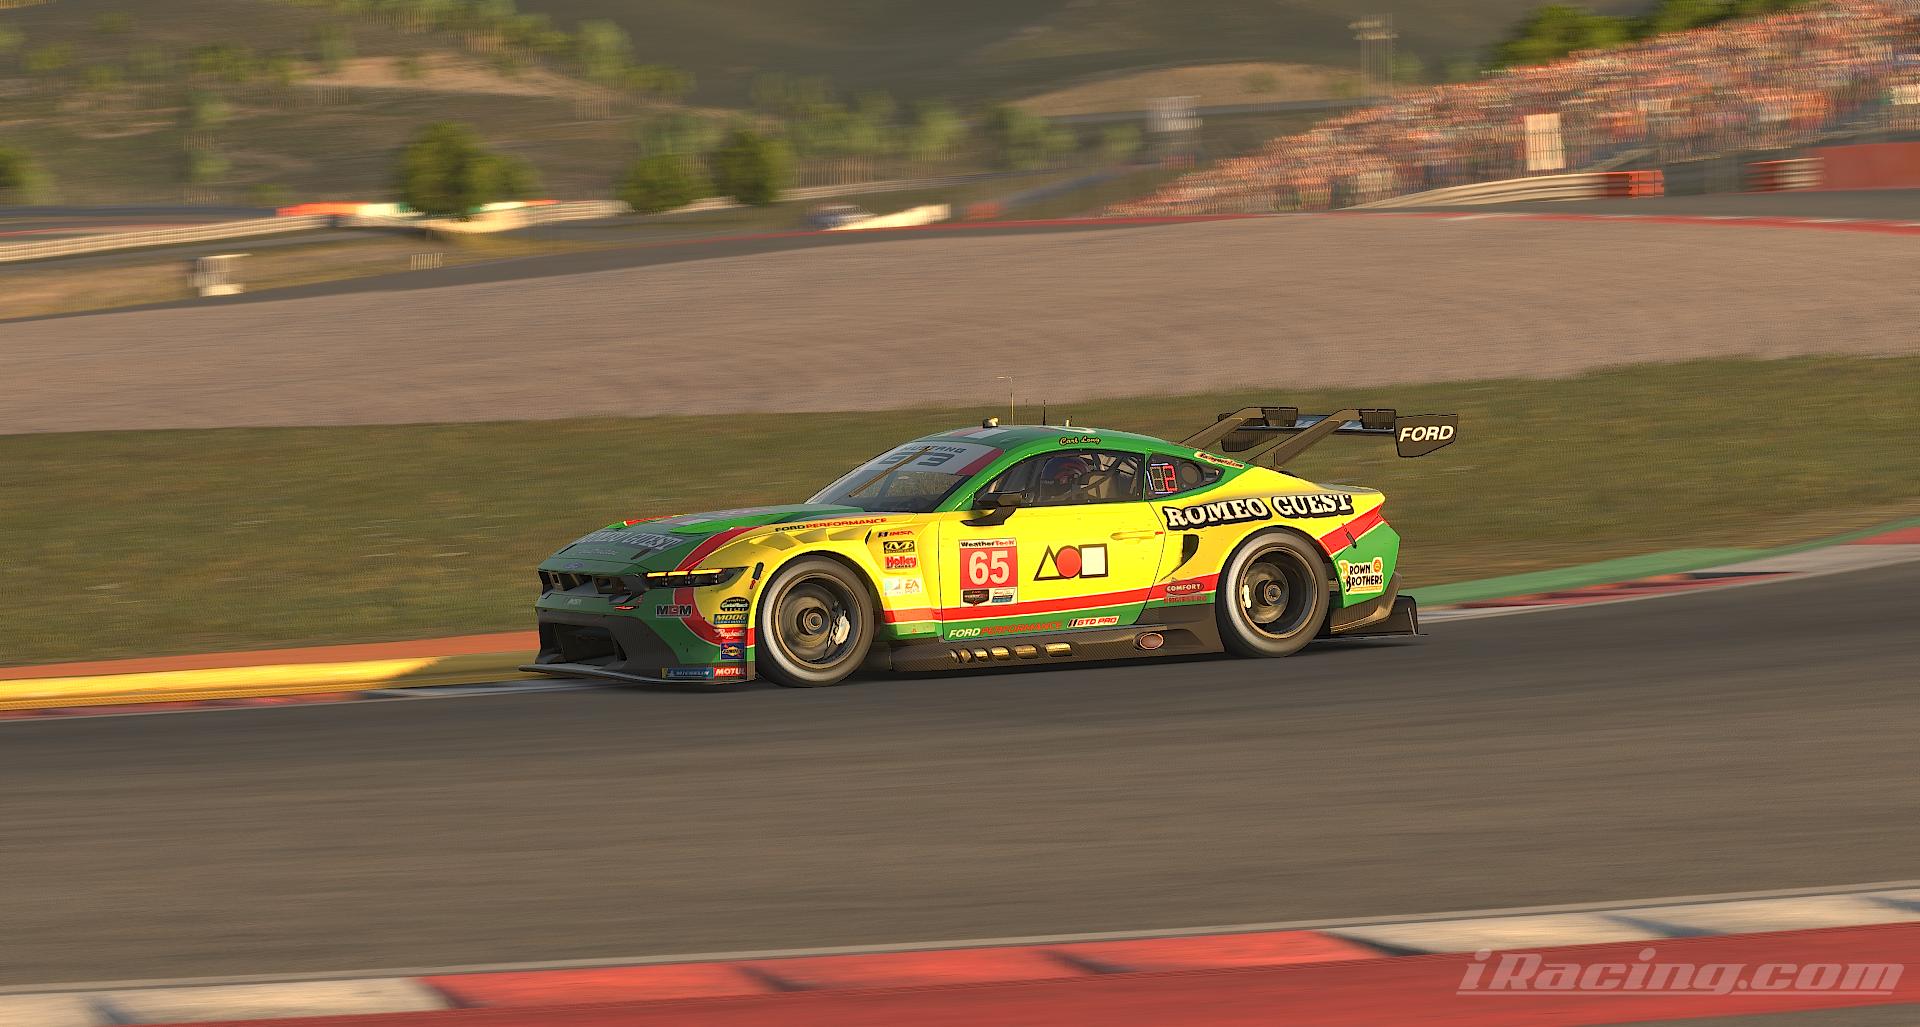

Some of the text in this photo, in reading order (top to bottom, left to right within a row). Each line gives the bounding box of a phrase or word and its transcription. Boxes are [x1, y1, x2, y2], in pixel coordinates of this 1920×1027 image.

[1399, 425, 1454, 442] FORD
[1163, 494, 1352, 527] ROMEO GUEST
[886, 556, 916, 568] Holley
[968, 550, 1010, 586] 65
[1167, 583, 1201, 592] COMFORT
[1346, 575, 1383, 592] BROTHERS
[715, 667, 746, 676] MOTUL
